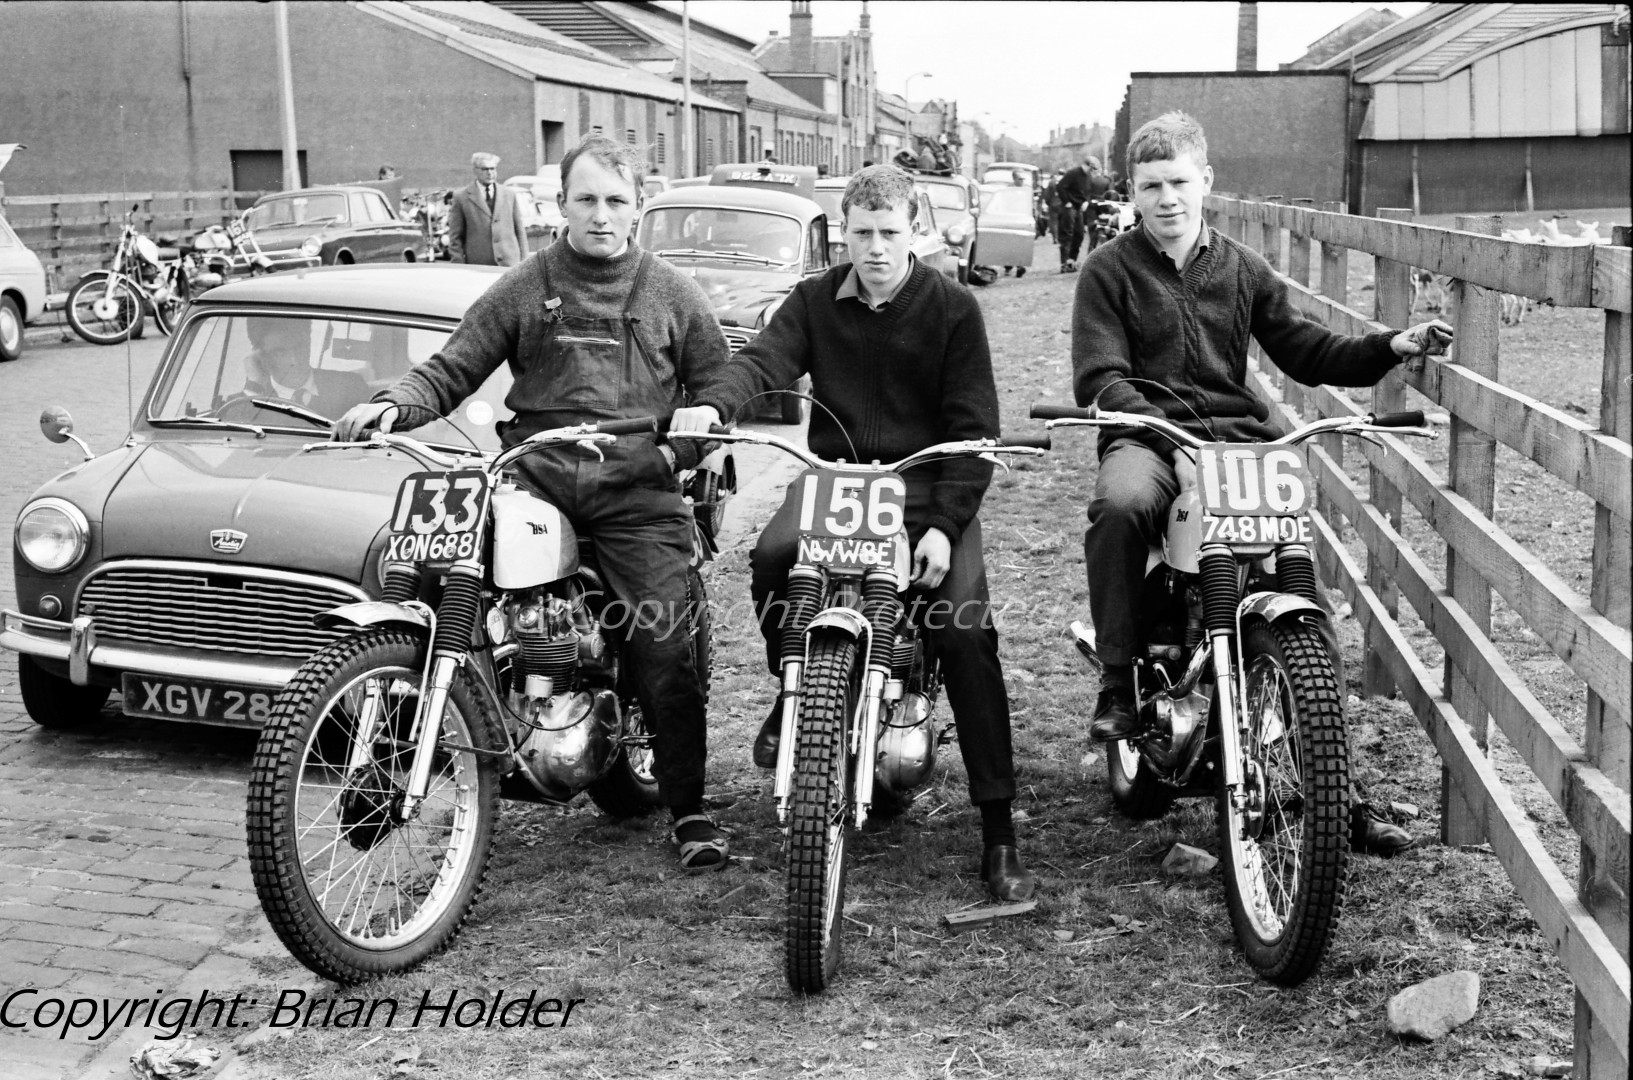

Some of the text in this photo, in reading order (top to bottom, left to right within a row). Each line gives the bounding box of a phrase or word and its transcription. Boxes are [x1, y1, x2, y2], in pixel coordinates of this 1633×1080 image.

[393, 477, 483, 534] 133
[799, 474, 906, 536] 156
[1201, 449, 1305, 512] 106
[526, 521, 548, 535] BSA
[141, 681, 282, 722] XGV 28
